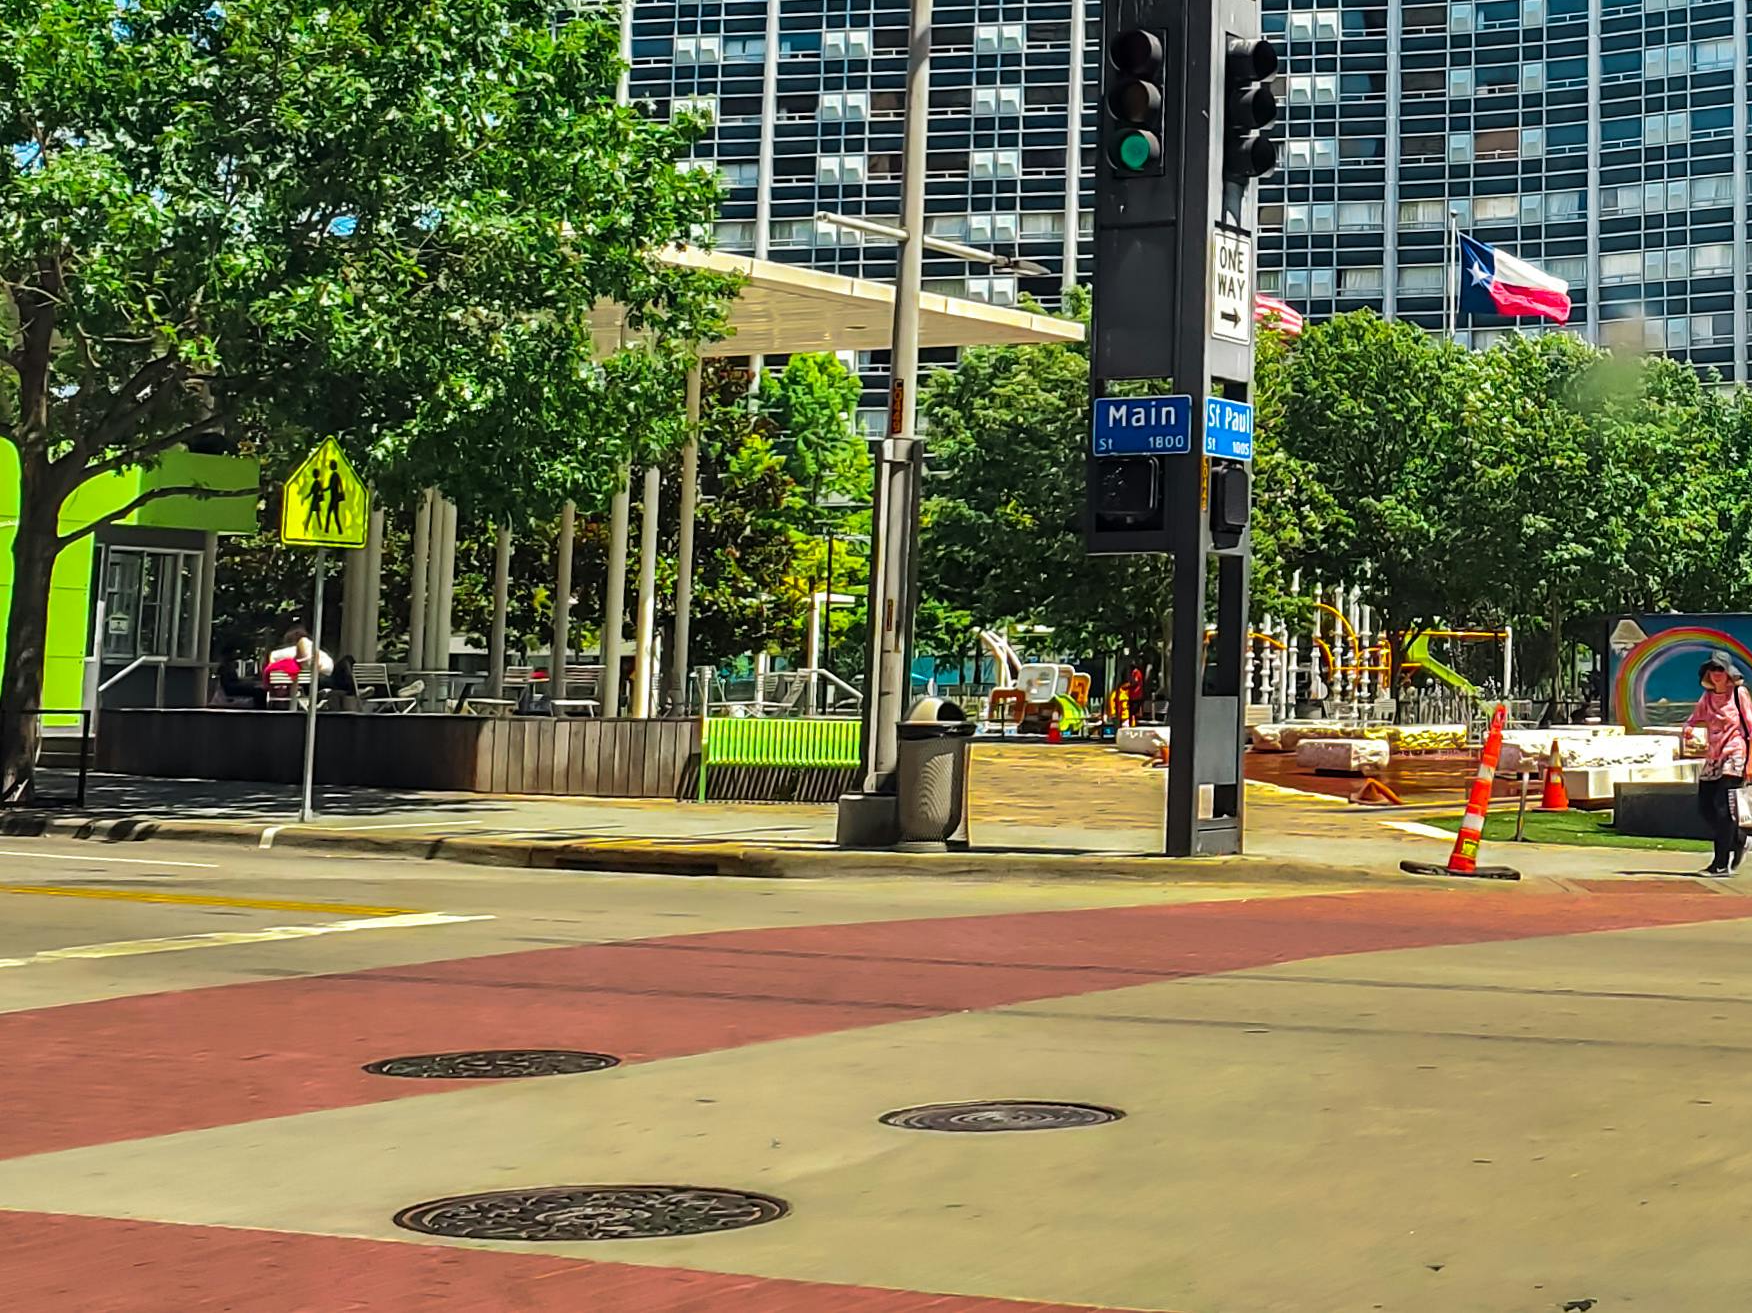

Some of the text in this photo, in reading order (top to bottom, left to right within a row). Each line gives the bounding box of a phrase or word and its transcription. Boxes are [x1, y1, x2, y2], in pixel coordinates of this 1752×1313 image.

[1219, 246, 1245, 274] ONE
[1217, 273, 1246, 302] WAY
[1108, 401, 1176, 428] Main
[1208, 403, 1250, 434] St Paul
[1099, 435, 1185, 451] St 1800
[1207, 436, 1250, 456] St 1005
